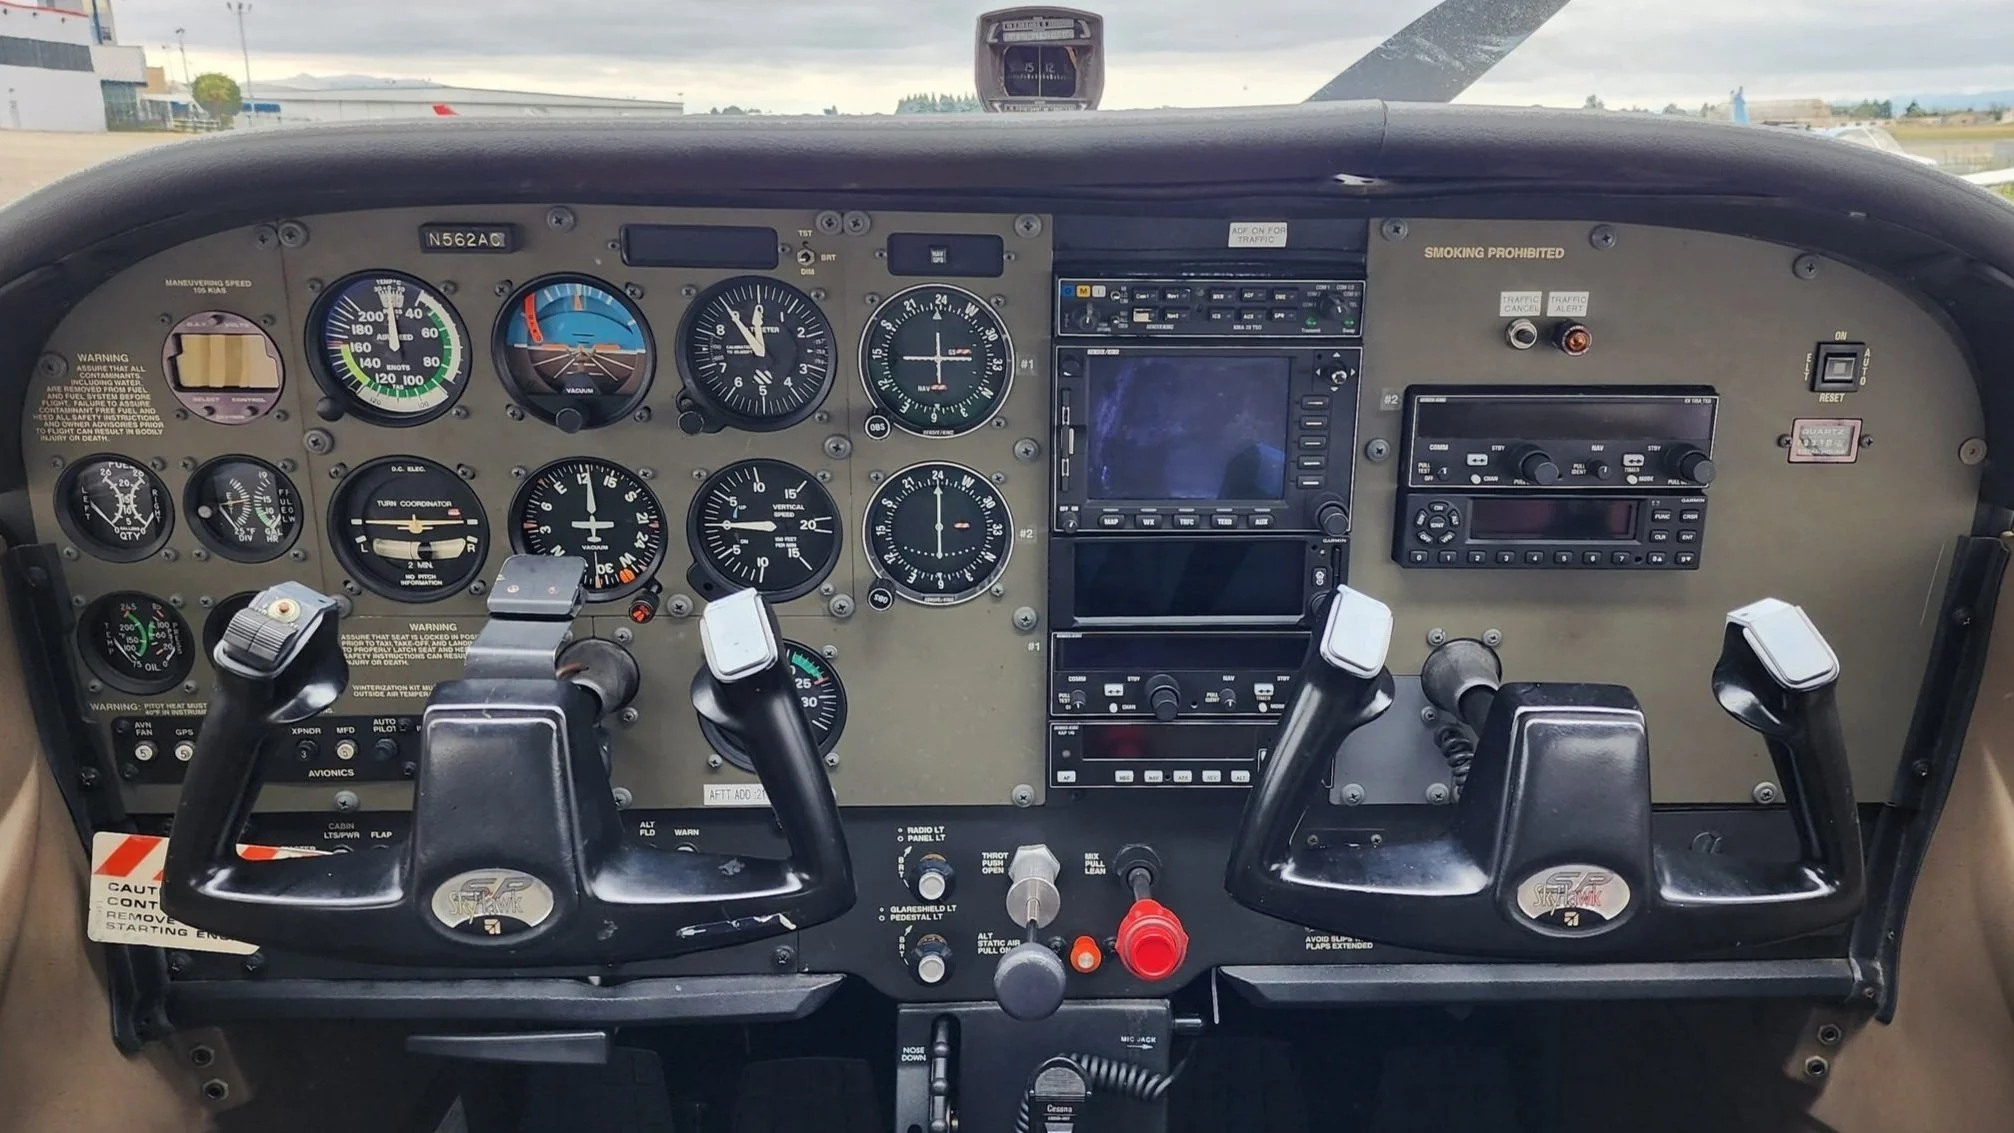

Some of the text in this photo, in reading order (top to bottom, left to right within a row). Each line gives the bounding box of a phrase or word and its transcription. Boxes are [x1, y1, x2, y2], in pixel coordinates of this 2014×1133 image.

[1232, 227, 1248, 235] ADF
[429, 232, 501, 247] N562AC
[1424, 247, 1565, 259] SMOKING PROHIBITED
[935, 294, 947, 305] 24
[1502, 296, 1540, 304] TRAFFIC
[1550, 296, 1586, 304] TRAFFIC
[358, 311, 384, 322] 200
[405, 308, 423, 319] 40
[351, 324, 373, 335] 180
[421, 328, 439, 338] 60
[716, 324, 725, 336] 8
[796, 327, 806, 338] 2
[1834, 331, 1847, 340] ON
[350, 342, 372, 352] 160
[77, 353, 129, 363] WARNING
[360, 358, 381, 368] 140
[423, 356, 440, 367] 80
[719, 362, 727, 373] 7
[799, 364, 808, 374] 3
[1020, 359, 1034, 369] #1
[1804, 353, 1812, 381] ELT
[1860, 348, 1871, 386] AUTO
[375, 373, 396, 384] 120
[403, 375, 424, 385] 100
[734, 377, 743, 387] 6
[783, 377, 792, 387] 4
[759, 385, 767, 396] 5
[1384, 395, 1399, 404] #2
[1819, 393, 1845, 403] RESET
[870, 423, 885, 431] OBS
[753, 482, 765, 493] 10
[784, 489, 797, 499] 15
[729, 496, 738, 506] 5
[800, 520, 817, 530] 20
[120, 532, 141, 541] QTY
[1020, 529, 1033, 539] #2
[360, 544, 368, 552] L
[467, 544, 476, 552] R
[409, 623, 457, 632] WARNING
[144, 663, 161, 672] OIL
[795, 678, 811, 689] 25
[801, 697, 818, 707] 30
[292, 727, 321, 735] XPNDR
[308, 769, 355, 777] AVIONICS
[108, 882, 161, 896] CAUT
[106, 911, 176, 925] REMOVE
[105, 922, 188, 937] STARTING
[903, 1046, 925, 1054] NOSE
[901, 1054, 926, 1062] DOWN
[1047, 1104, 1072, 1113] Cessna
